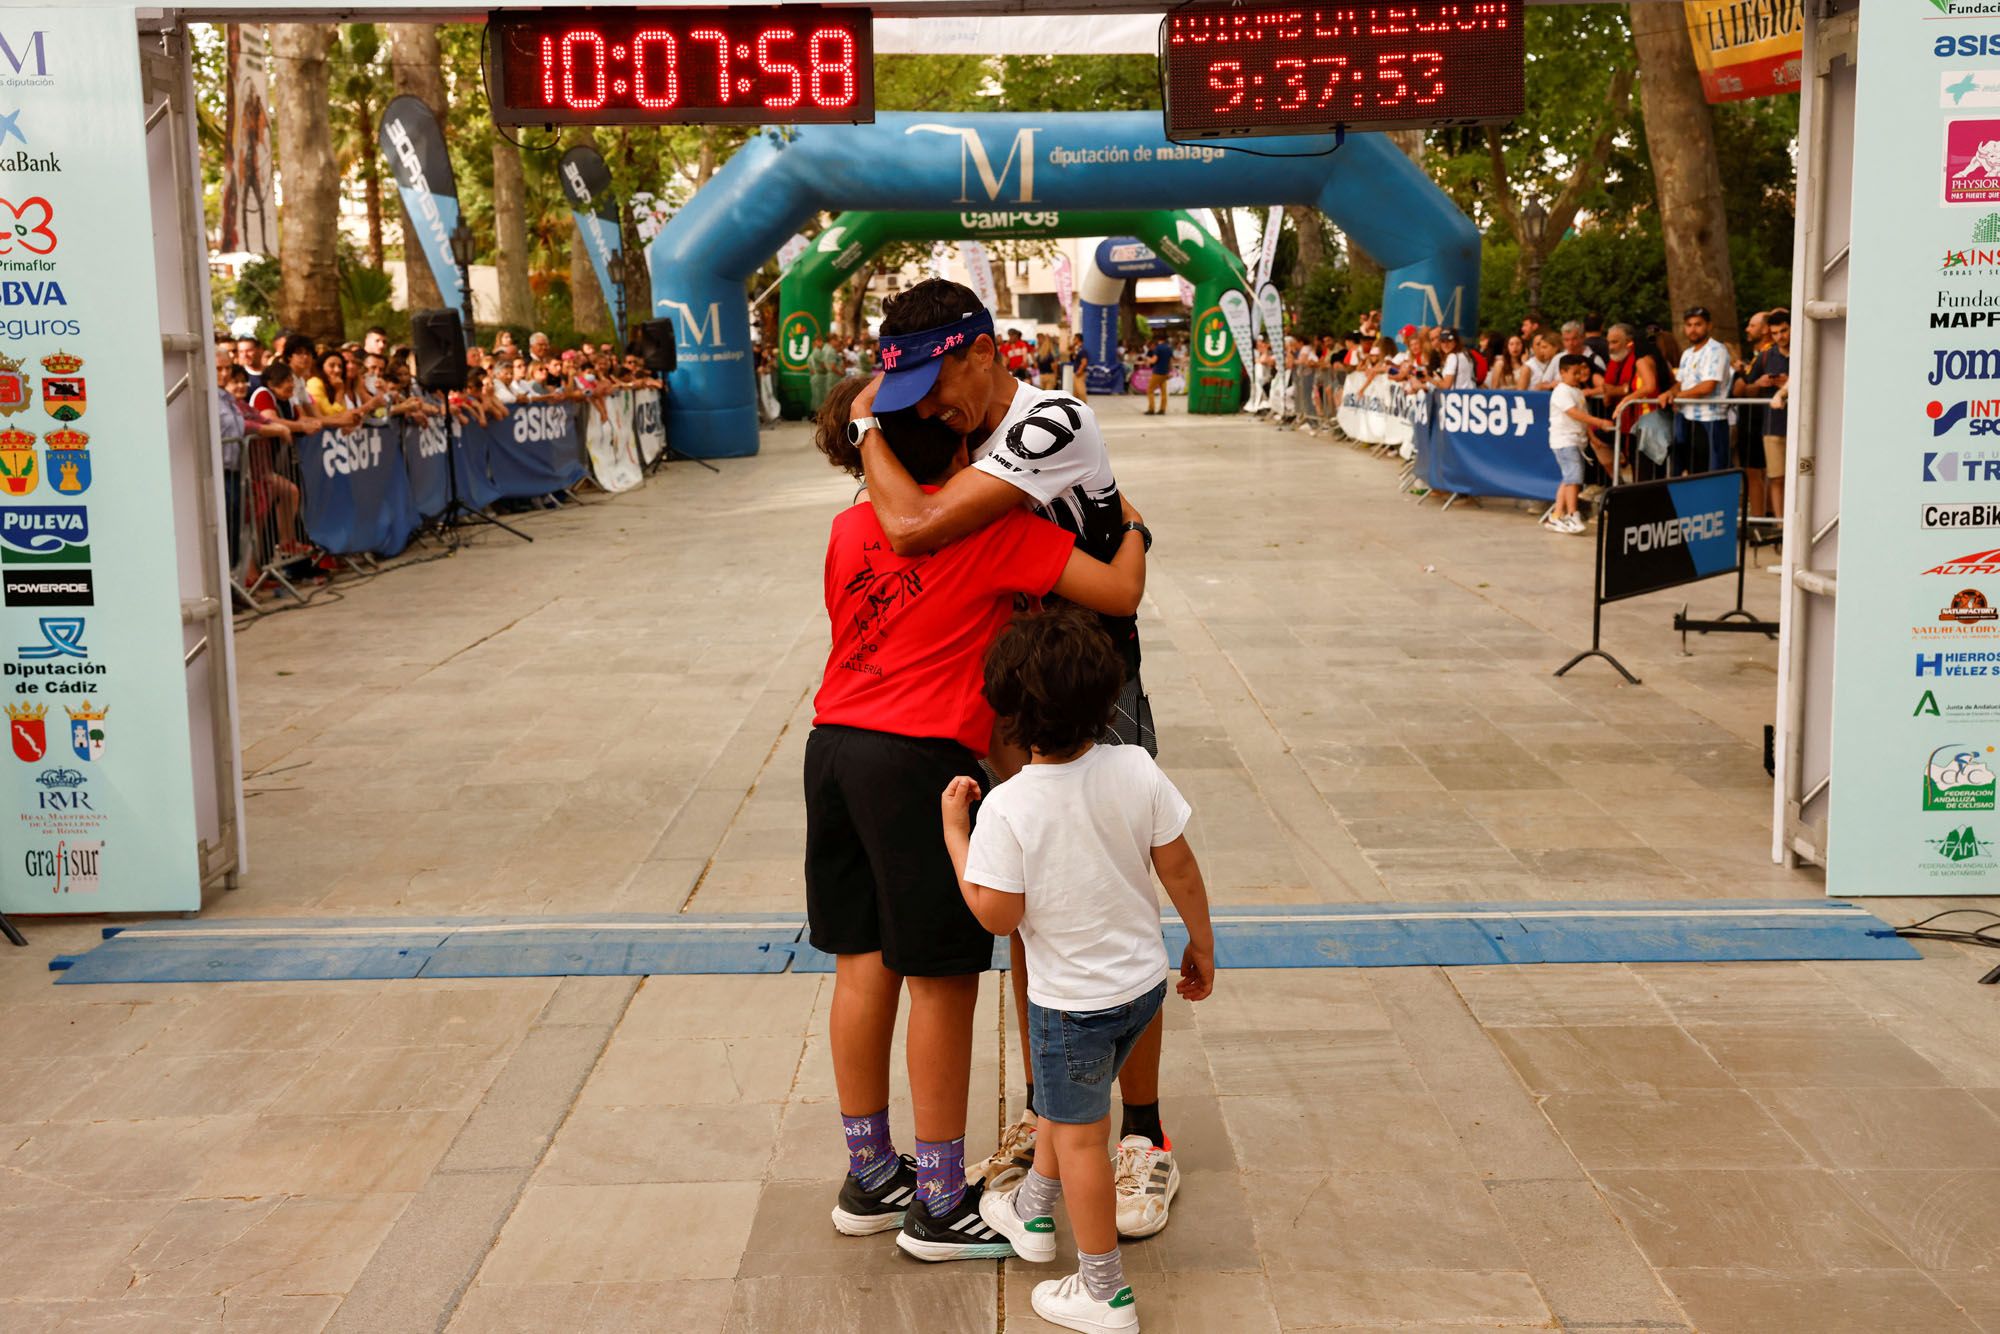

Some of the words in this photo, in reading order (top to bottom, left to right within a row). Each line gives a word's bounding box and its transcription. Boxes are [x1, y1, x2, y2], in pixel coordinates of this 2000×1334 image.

[542, 29, 855, 109] 10:07:58
[1209, 52, 1443, 113] 9:37:53
[905, 124, 1043, 203] M
[1050, 145, 1129, 168] diputación
[1133, 145, 1152, 162] de
[0, 281, 68, 306] BVA
[993, 454, 1013, 470] ARE
[4, 512, 84, 530] PULEVA
[1624, 510, 1725, 555] POWERADE
[863, 541, 881, 550] LA
[7, 583, 90, 593] POWERADE
[4, 662, 107, 678] Diputación
[1945, 664, 1987, 676] VÉLEZ
[16, 682, 39, 694] de
[45, 681, 98, 694] Cádiz
